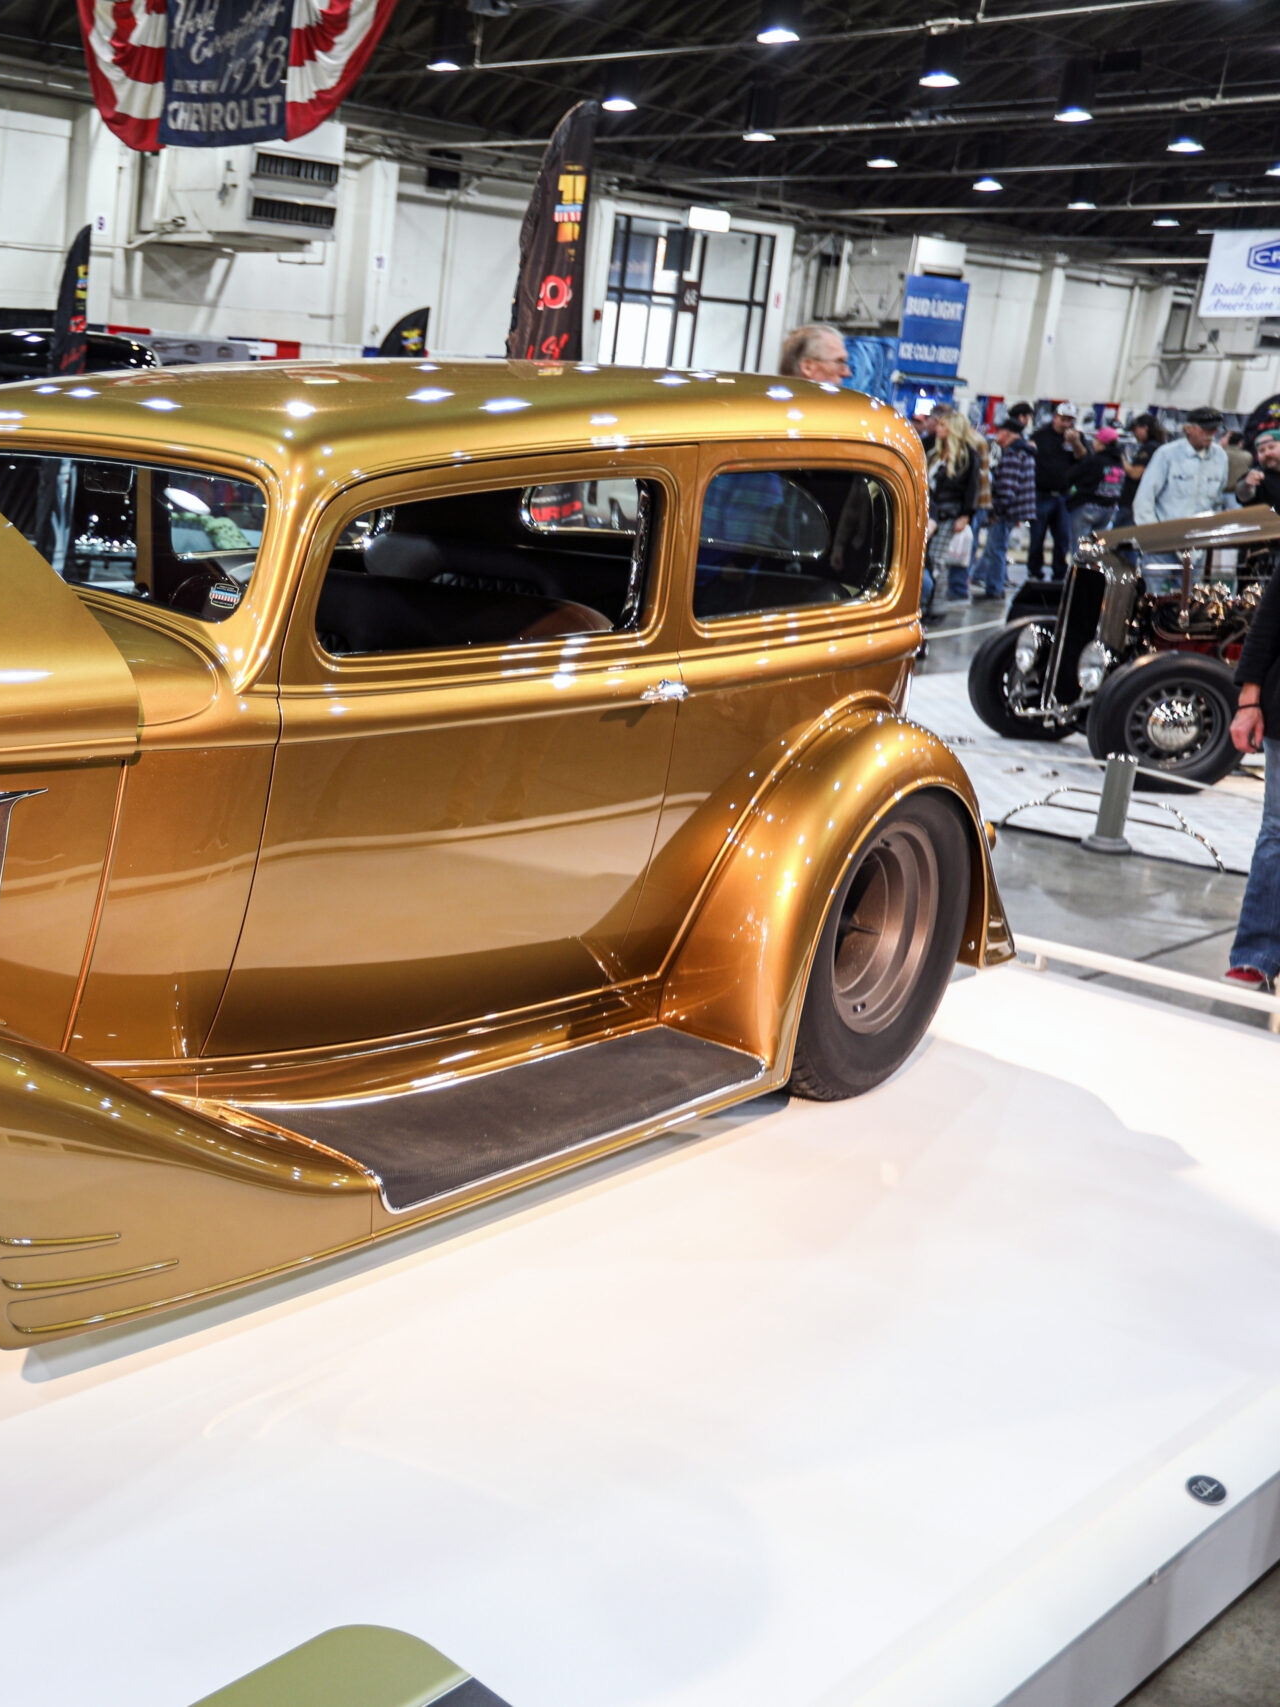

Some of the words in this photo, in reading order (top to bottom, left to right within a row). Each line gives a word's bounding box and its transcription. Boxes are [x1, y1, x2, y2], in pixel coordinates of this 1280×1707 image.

[220, 35, 289, 94] 1938
[167, 95, 282, 132] CHEVROLET
[905, 295, 930, 317] BUD
[931, 298, 964, 321] LIGHT
[899, 342, 913, 360] ICE
[913, 343, 937, 362] COLD
[937, 345, 960, 364] BEER
